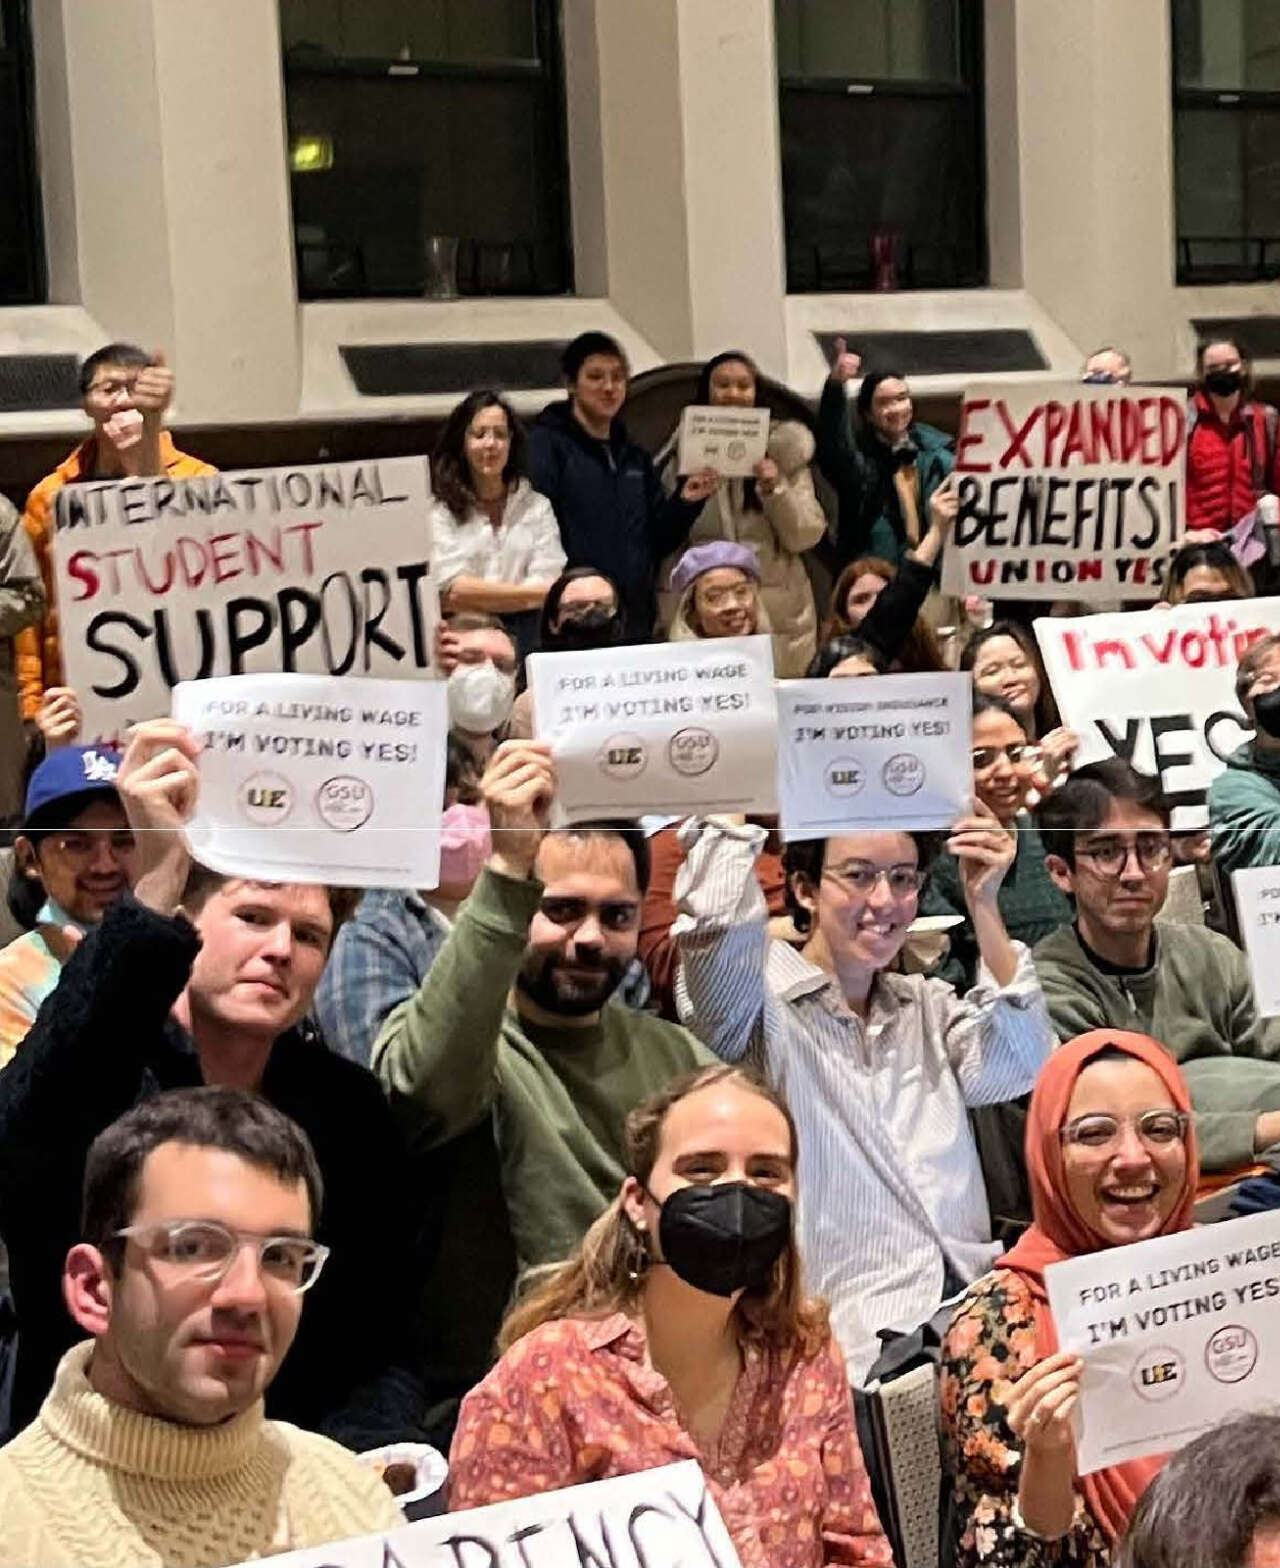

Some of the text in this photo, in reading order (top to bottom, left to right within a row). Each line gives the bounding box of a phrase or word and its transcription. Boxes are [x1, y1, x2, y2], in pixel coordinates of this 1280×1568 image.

[956, 397, 1186, 472] EXPANDED
[55, 465, 408, 529] INTERNATIONAL
[955, 476, 1177, 551] BENEFITS!
[68, 521, 323, 601] STUDENT
[970, 558, 1102, 585] UNION
[86, 561, 430, 698] SUPPORT
[558, 664, 747, 690] FOR A LIVING WAGE
[204, 701, 422, 727] FOR A LIVING WAGE
[562, 692, 749, 723] I'M VOTING YES!
[203, 730, 419, 762] I'M VOTING YES!
[835, 722, 905, 740] VOTING
[912, 720, 950, 737] YES!
[1079, 1281, 1122, 1306] FOR
[1129, 1278, 1143, 1295] A
[1147, 1259, 1220, 1289] LIVING
[1088, 1320, 1128, 1343] I'M
[1134, 1292, 1227, 1331] VOTING
[1212, 1332, 1248, 1355] GSU
